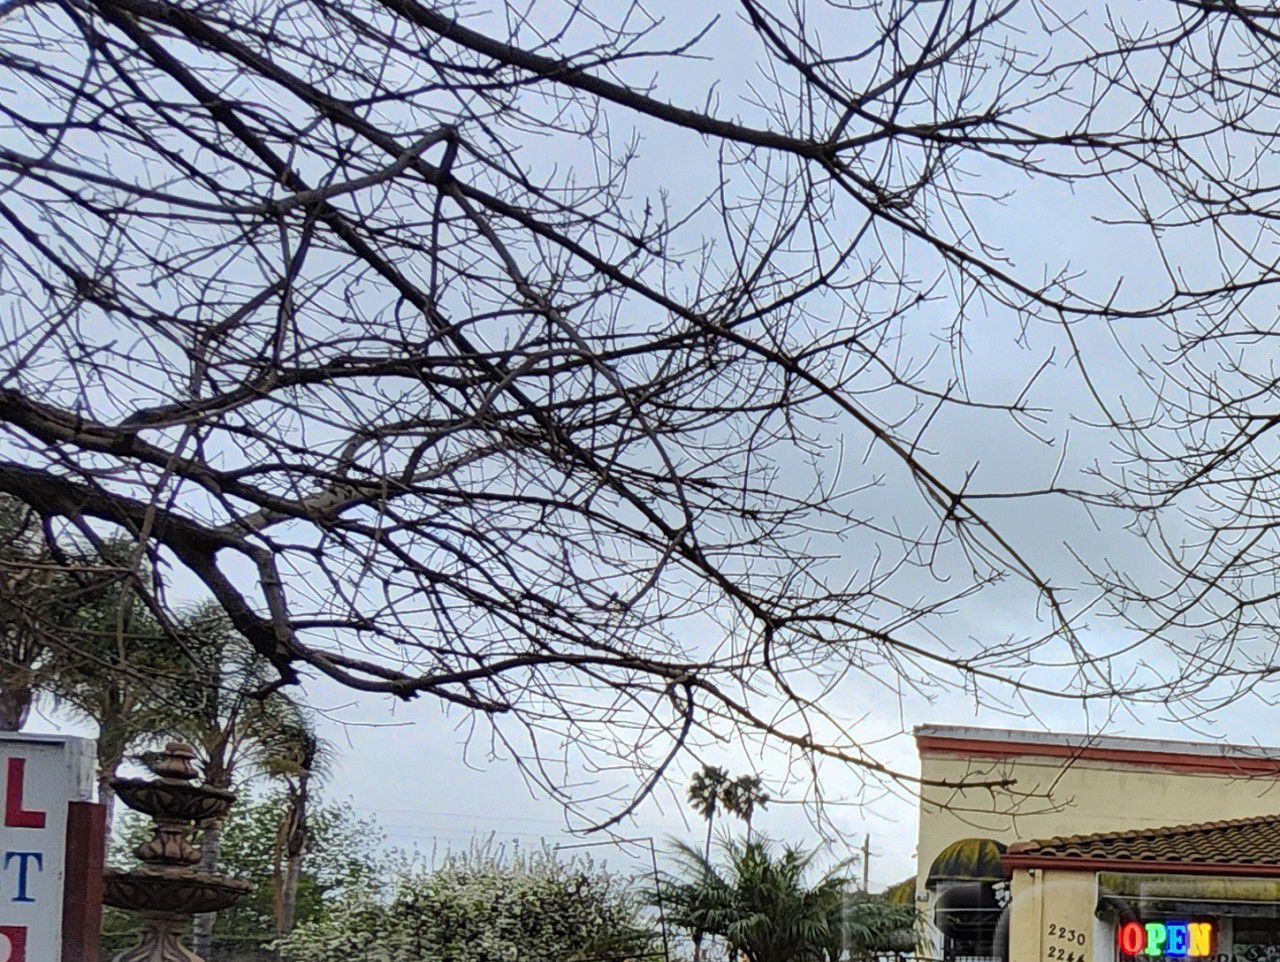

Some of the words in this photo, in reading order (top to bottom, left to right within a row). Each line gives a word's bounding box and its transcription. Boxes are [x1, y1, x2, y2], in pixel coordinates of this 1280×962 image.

[5, 757, 46, 829] L
[1048, 923, 1086, 946] 2230
[1120, 922, 1212, 957] OPEN
